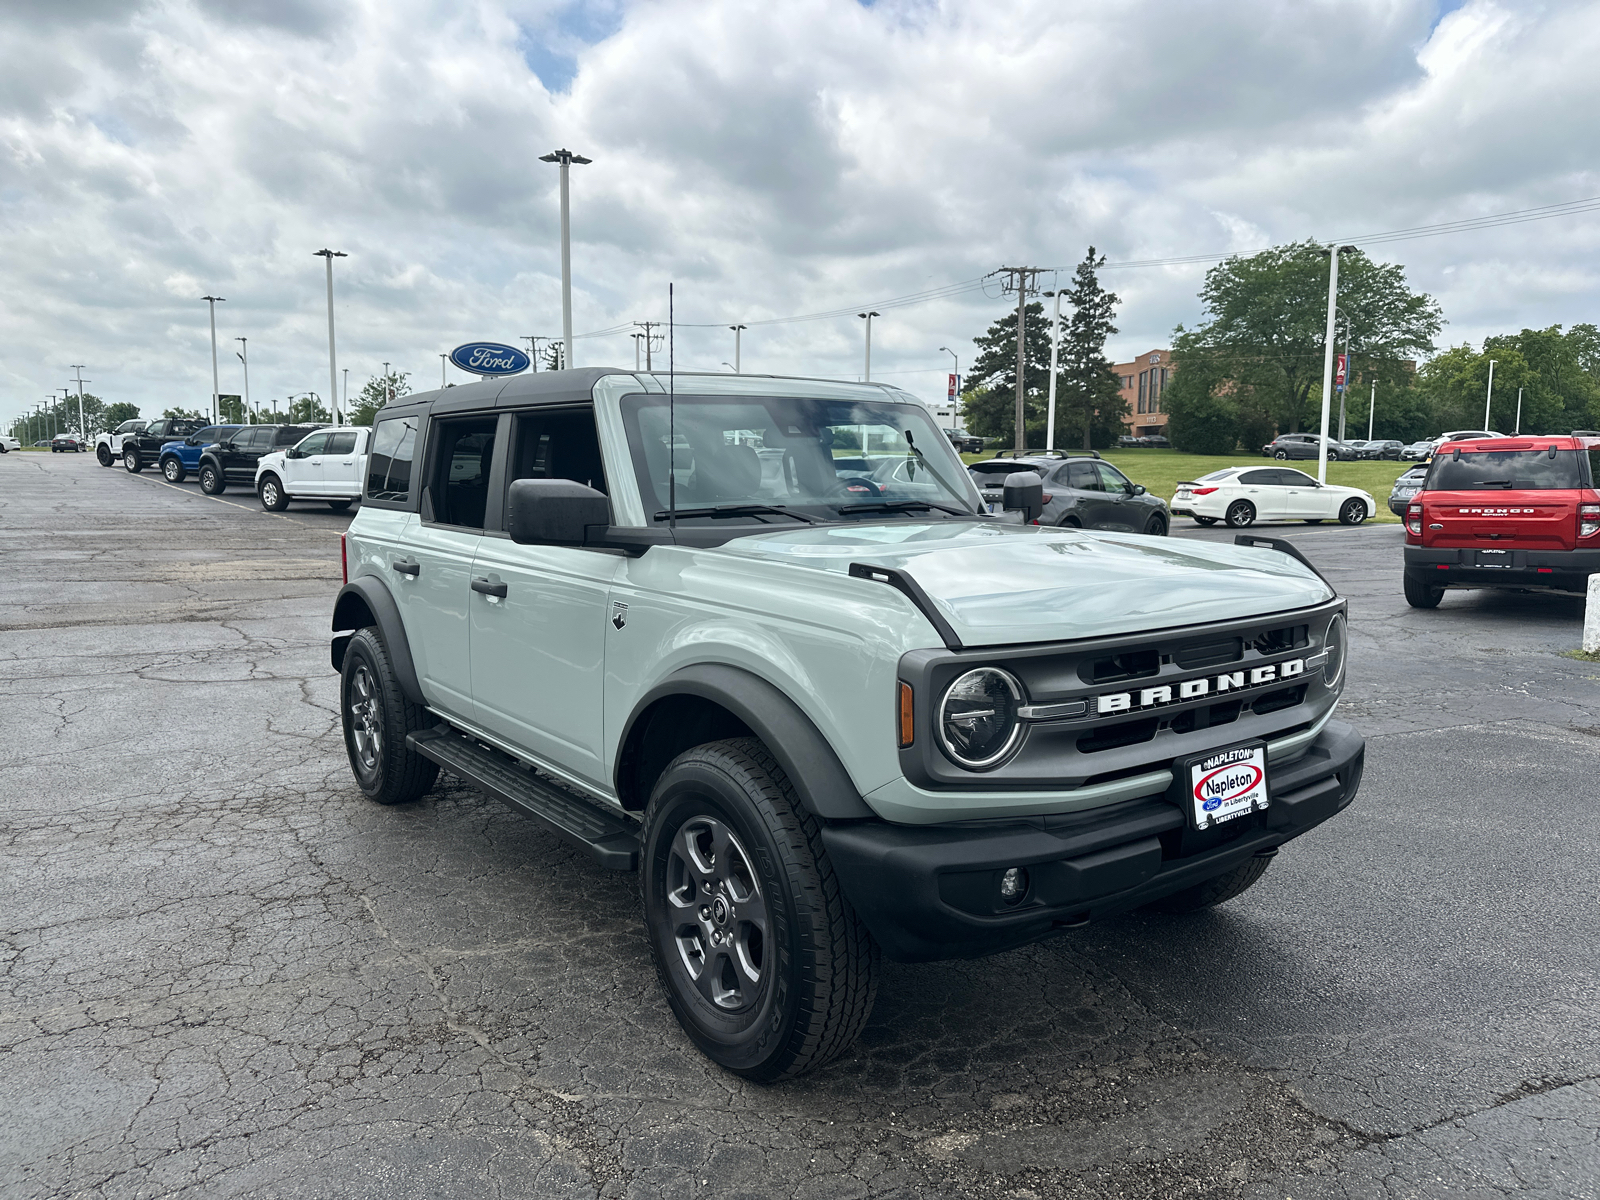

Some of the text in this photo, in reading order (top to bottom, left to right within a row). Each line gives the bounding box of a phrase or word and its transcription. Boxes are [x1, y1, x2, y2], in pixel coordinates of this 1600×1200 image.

[469, 347, 515, 369] Ford
[1097, 658, 1303, 713] BRONCO
[1207, 749, 1250, 769] NAPLETON
[1206, 773, 1252, 796] Napleton
[1206, 797, 1220, 810] Ford
[1230, 792, 1259, 806] Libertyville
[1215, 807, 1252, 824] LIBERTYVILLE
